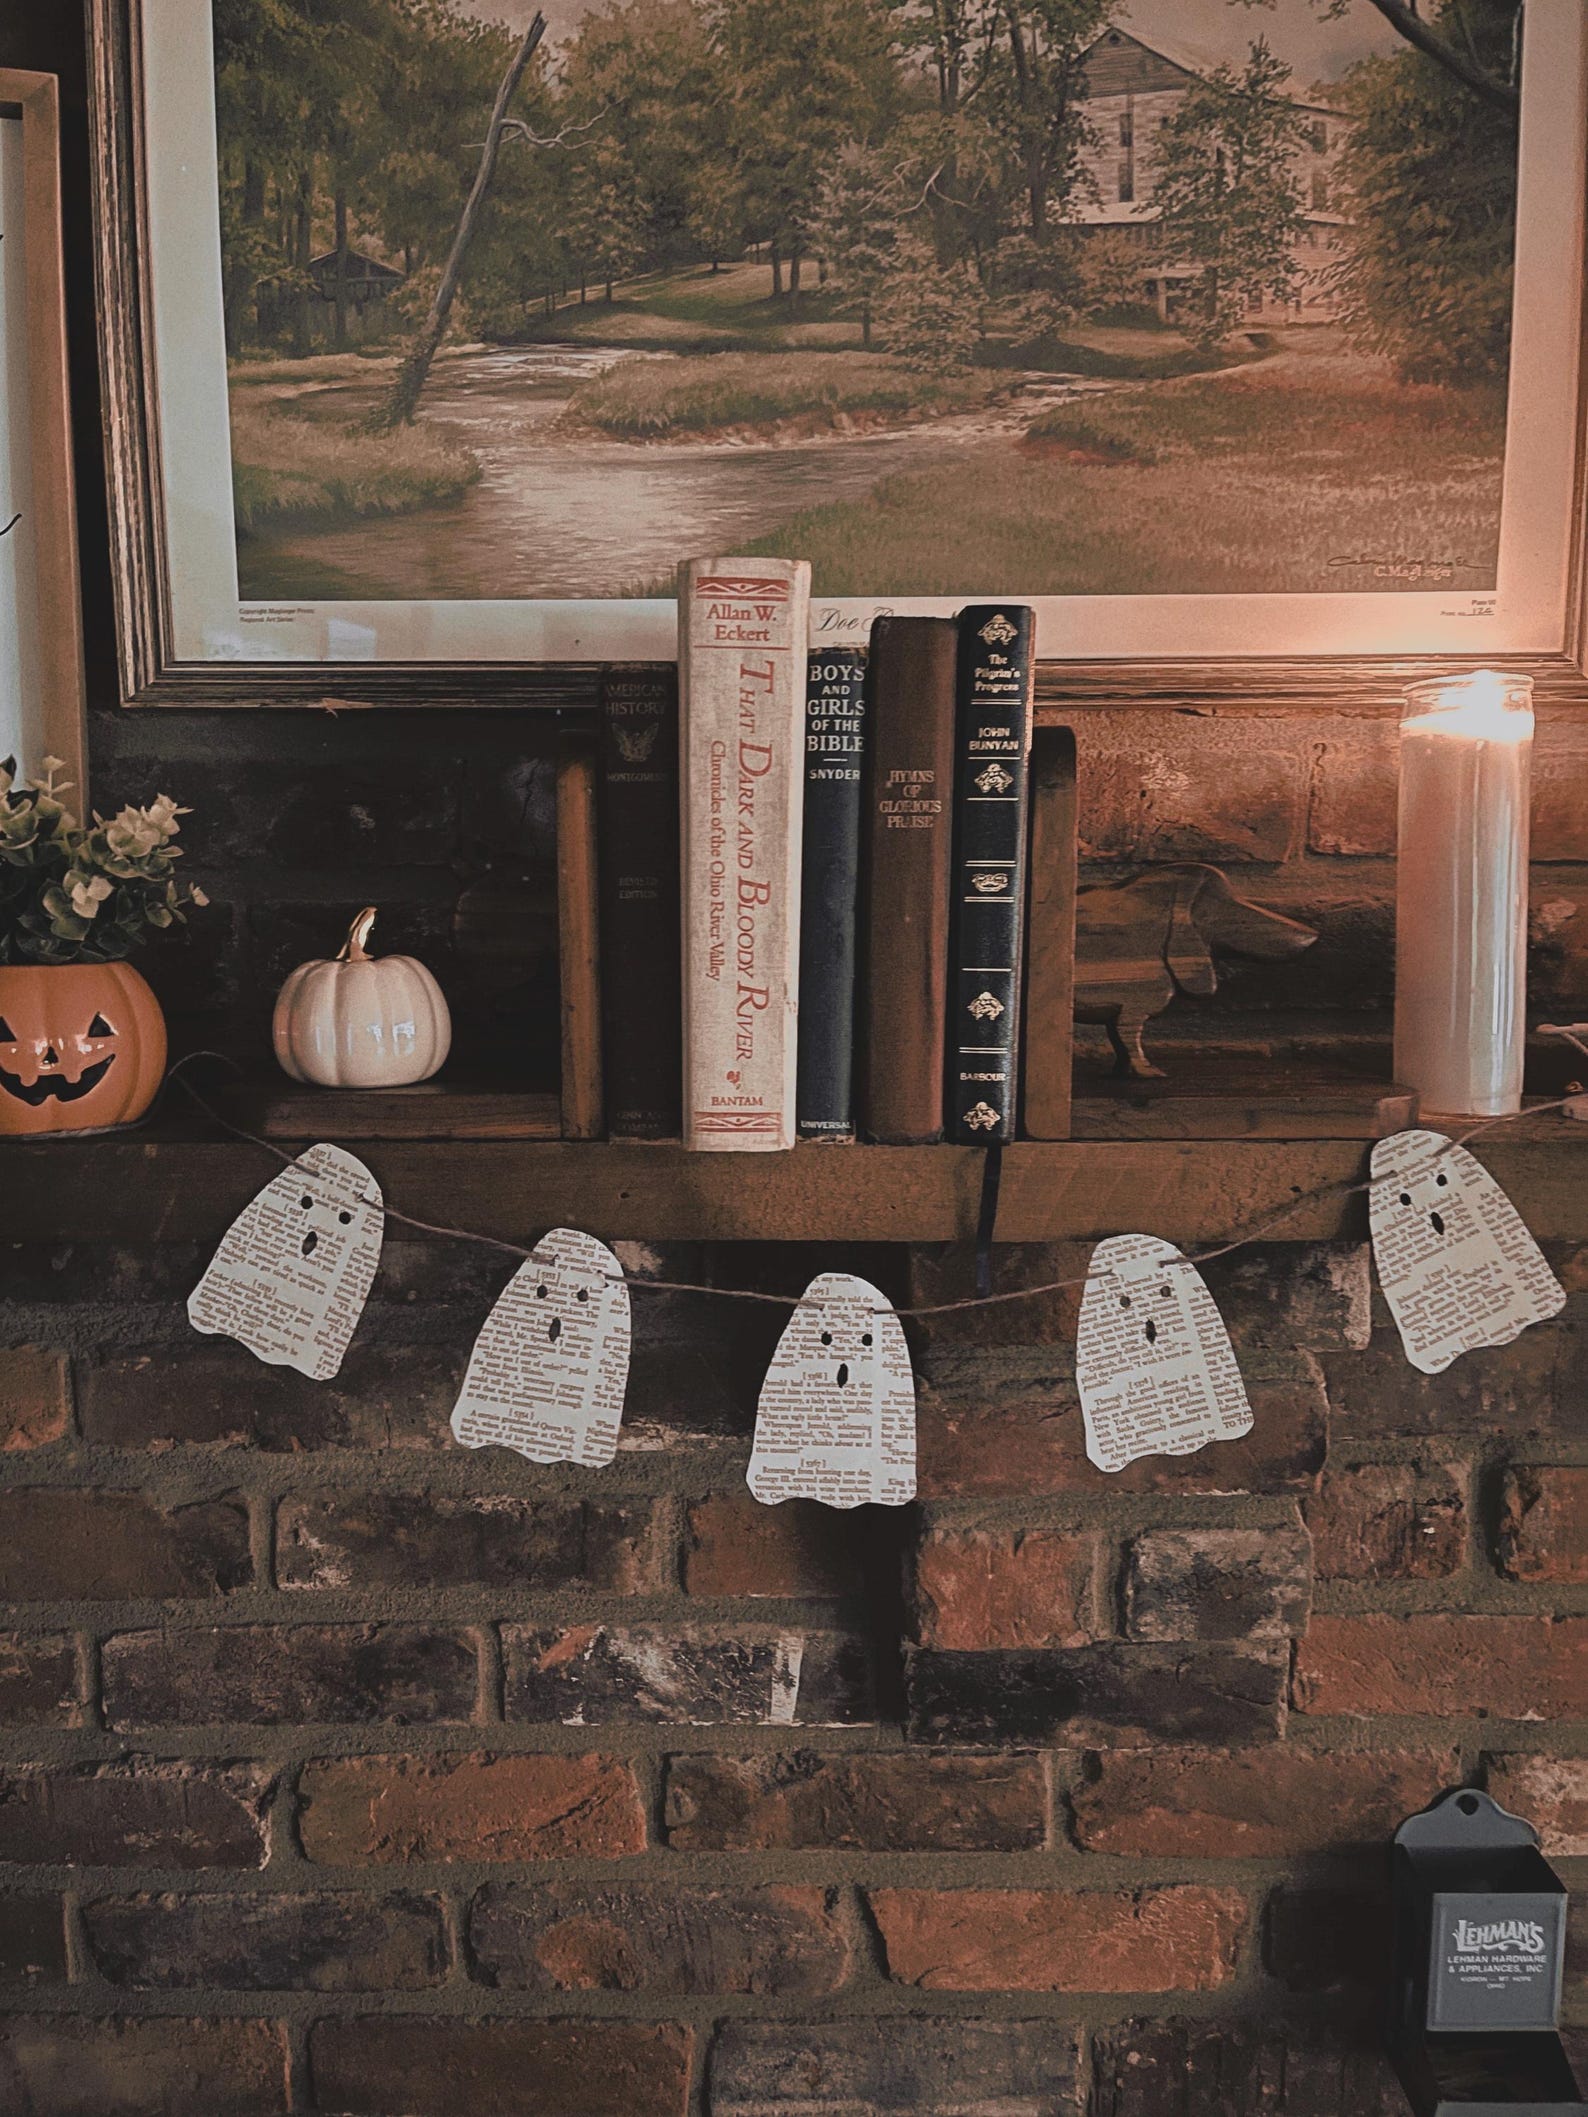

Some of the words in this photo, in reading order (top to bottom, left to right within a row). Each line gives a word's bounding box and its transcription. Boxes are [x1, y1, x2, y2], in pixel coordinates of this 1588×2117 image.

[706, 604, 751, 622] Allan
[753, 605, 777, 622] W.
[814, 607, 860, 633] Doe
[713, 624, 771, 642] Eckert
[988, 654, 1009, 665] The
[809, 665, 865, 682] BOYS
[974, 667, 1022, 680] Pilgrim's
[821, 685, 851, 696] AND
[974, 681, 1020, 694] Progress
[739, 660, 775, 734] THAT
[807, 699, 866, 716] GIRLS
[811, 719, 830, 732] OF
[834, 720, 860, 733] THE
[978, 728, 1011, 738] JOHN
[807, 735, 865, 753] BIBLE
[969, 740, 1020, 751] BUNYAN
[711, 740, 727, 815] Chronicles
[738, 738, 773, 817] DARK
[809, 768, 861, 781] SNYDER
[889, 769, 936, 784] HYMNS
[903, 784, 922, 799] OF
[879, 799, 943, 814] GLORIOUS
[711, 816, 727, 834] of
[887, 815, 935, 829] PRISE
[710, 834, 726, 857] the
[737, 821, 754, 869] AND
[710, 860, 726, 898] Ohio
[710, 901, 725, 940] River
[737, 875, 772, 979] BLOODY
[706, 941, 726, 982] Valley
[736, 980, 770, 1062] RIVER
[959, 1072, 1008, 1082] BARBOUR
[711, 1096, 764, 1107] BANTAM
[801, 1119, 852, 1130] UNIVERSAL
[1452, 1919, 1545, 1954] LEHMAN'S
[1447, 1955, 1489, 1964] LEHMAN
[1491, 1954, 1548, 1963] HARDWARE
[1459, 1964, 1522, 1973] APPLIANCES,
